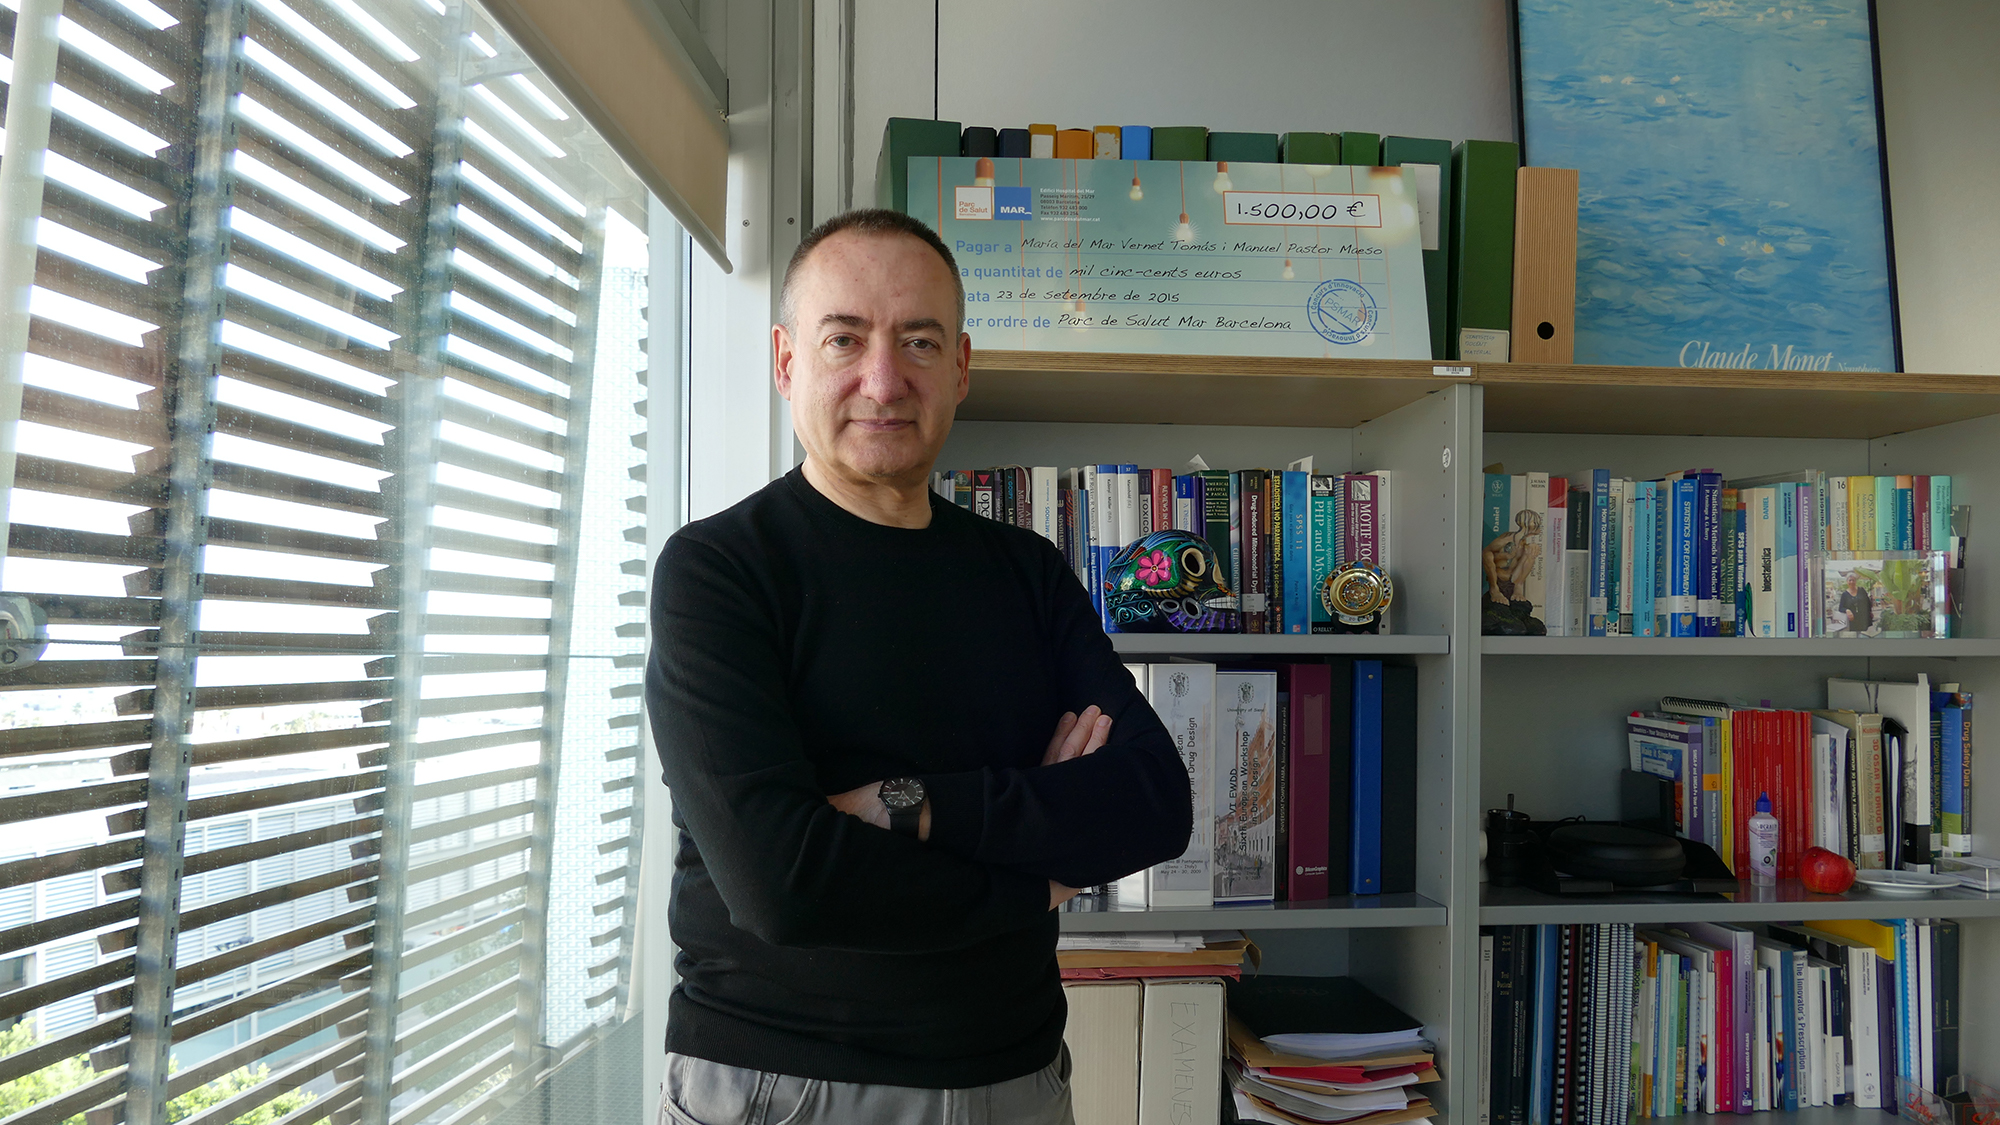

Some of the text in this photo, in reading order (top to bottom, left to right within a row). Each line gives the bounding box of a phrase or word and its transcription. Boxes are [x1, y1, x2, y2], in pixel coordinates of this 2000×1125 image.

[1237, 201, 1366, 220] 1.500,00 €
[956, 238, 1383, 256] Pagar a María del Mar Vernet Tomás i Manuel Pastor Maeso
[974, 266, 1041, 284] quantitat
[1045, 266, 1063, 278] de
[1069, 265, 1095, 277] mil
[1100, 266, 1189, 279] cinc-cents
[1194, 269, 1243, 280] euros
[964, 287, 1180, 304] ata 23 de setembre de 2015
[965, 313, 1292, 331] er ordre de Parc de Salut Mar Barcelona
[1325, 297, 1361, 326] PSMAR
[1678, 340, 1834, 372] Claude Monet
[1381, 477, 1386, 487] 3
[1837, 480, 1846, 490] 16
[1161, 485, 1169, 513] REVIEWS
[1250, 495, 1258, 536] Drug-Induced
[1296, 514, 1304, 535] SPSS
[1326, 500, 1334, 543] Web Database
[1360, 503, 1371, 538] MOTIF
[1683, 501, 1691, 538] STATISTICS
[1090, 552, 1098, 563] Drug
[1250, 538, 1258, 579] Mitochondrial
[1313, 500, 1325, 600] PHP and MySQL
[1656, 496, 1664, 597] Introductory Statistics
[1683, 540, 1691, 554] FOR
[1726, 530, 1735, 603] EXPERIMENTALES
[1187, 717, 1197, 773] Drug Design
[1962, 721, 1971, 741] Drug
[1962, 743, 1971, 767] Safety
[1229, 768, 1238, 814] VI EWDD
[1239, 731, 1250, 850] Sixth European Workshop
[1251, 757, 1259, 825] in Drug Design
[1866, 750, 1875, 812] Theory Methods and
[1873, 739, 1882, 823] 3D QSAR IN DRUG
[1962, 769, 1971, 787] Data
[1851, 804, 1859, 834] TRANSPORTE
[1851, 835, 1859, 845] DEL
[1796, 962, 1807, 1070] The Innovator's Prescription
[1169, 1001, 1198, 1125] EXAMENES
